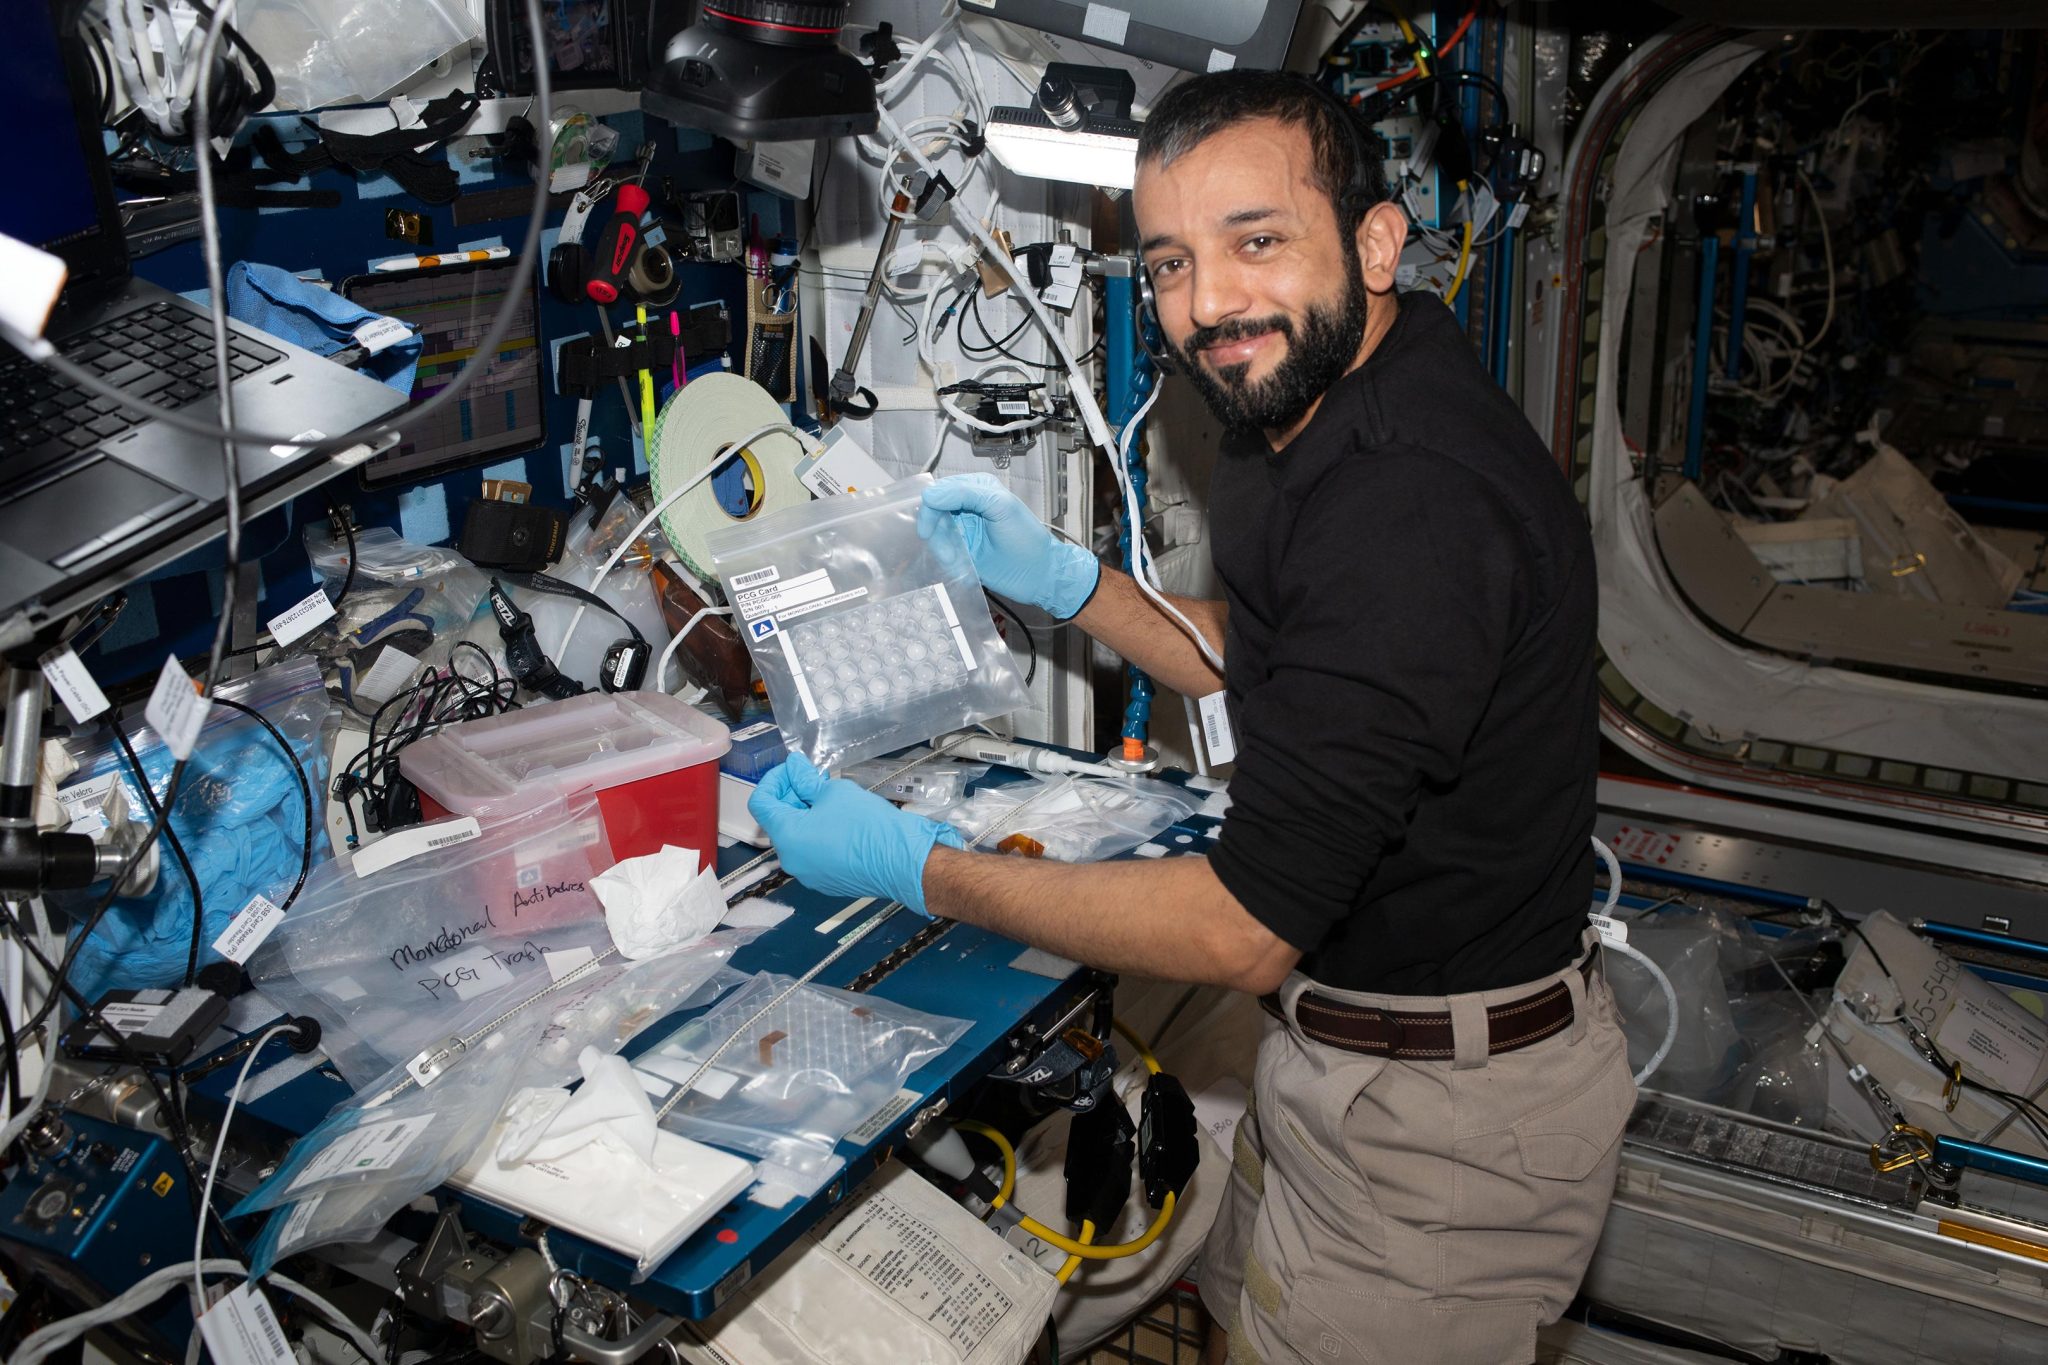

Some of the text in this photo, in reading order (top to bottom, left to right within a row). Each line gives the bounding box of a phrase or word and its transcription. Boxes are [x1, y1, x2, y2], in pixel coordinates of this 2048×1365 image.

[737, 584, 778, 601] PCG Card
[491, 592, 516, 627] PETZL
[744, 607, 769, 620] Quantity
[70, 787, 93, 800] Velcro
[235, 926, 253, 947] Reader
[417, 941, 551, 1000] PCG Trash
